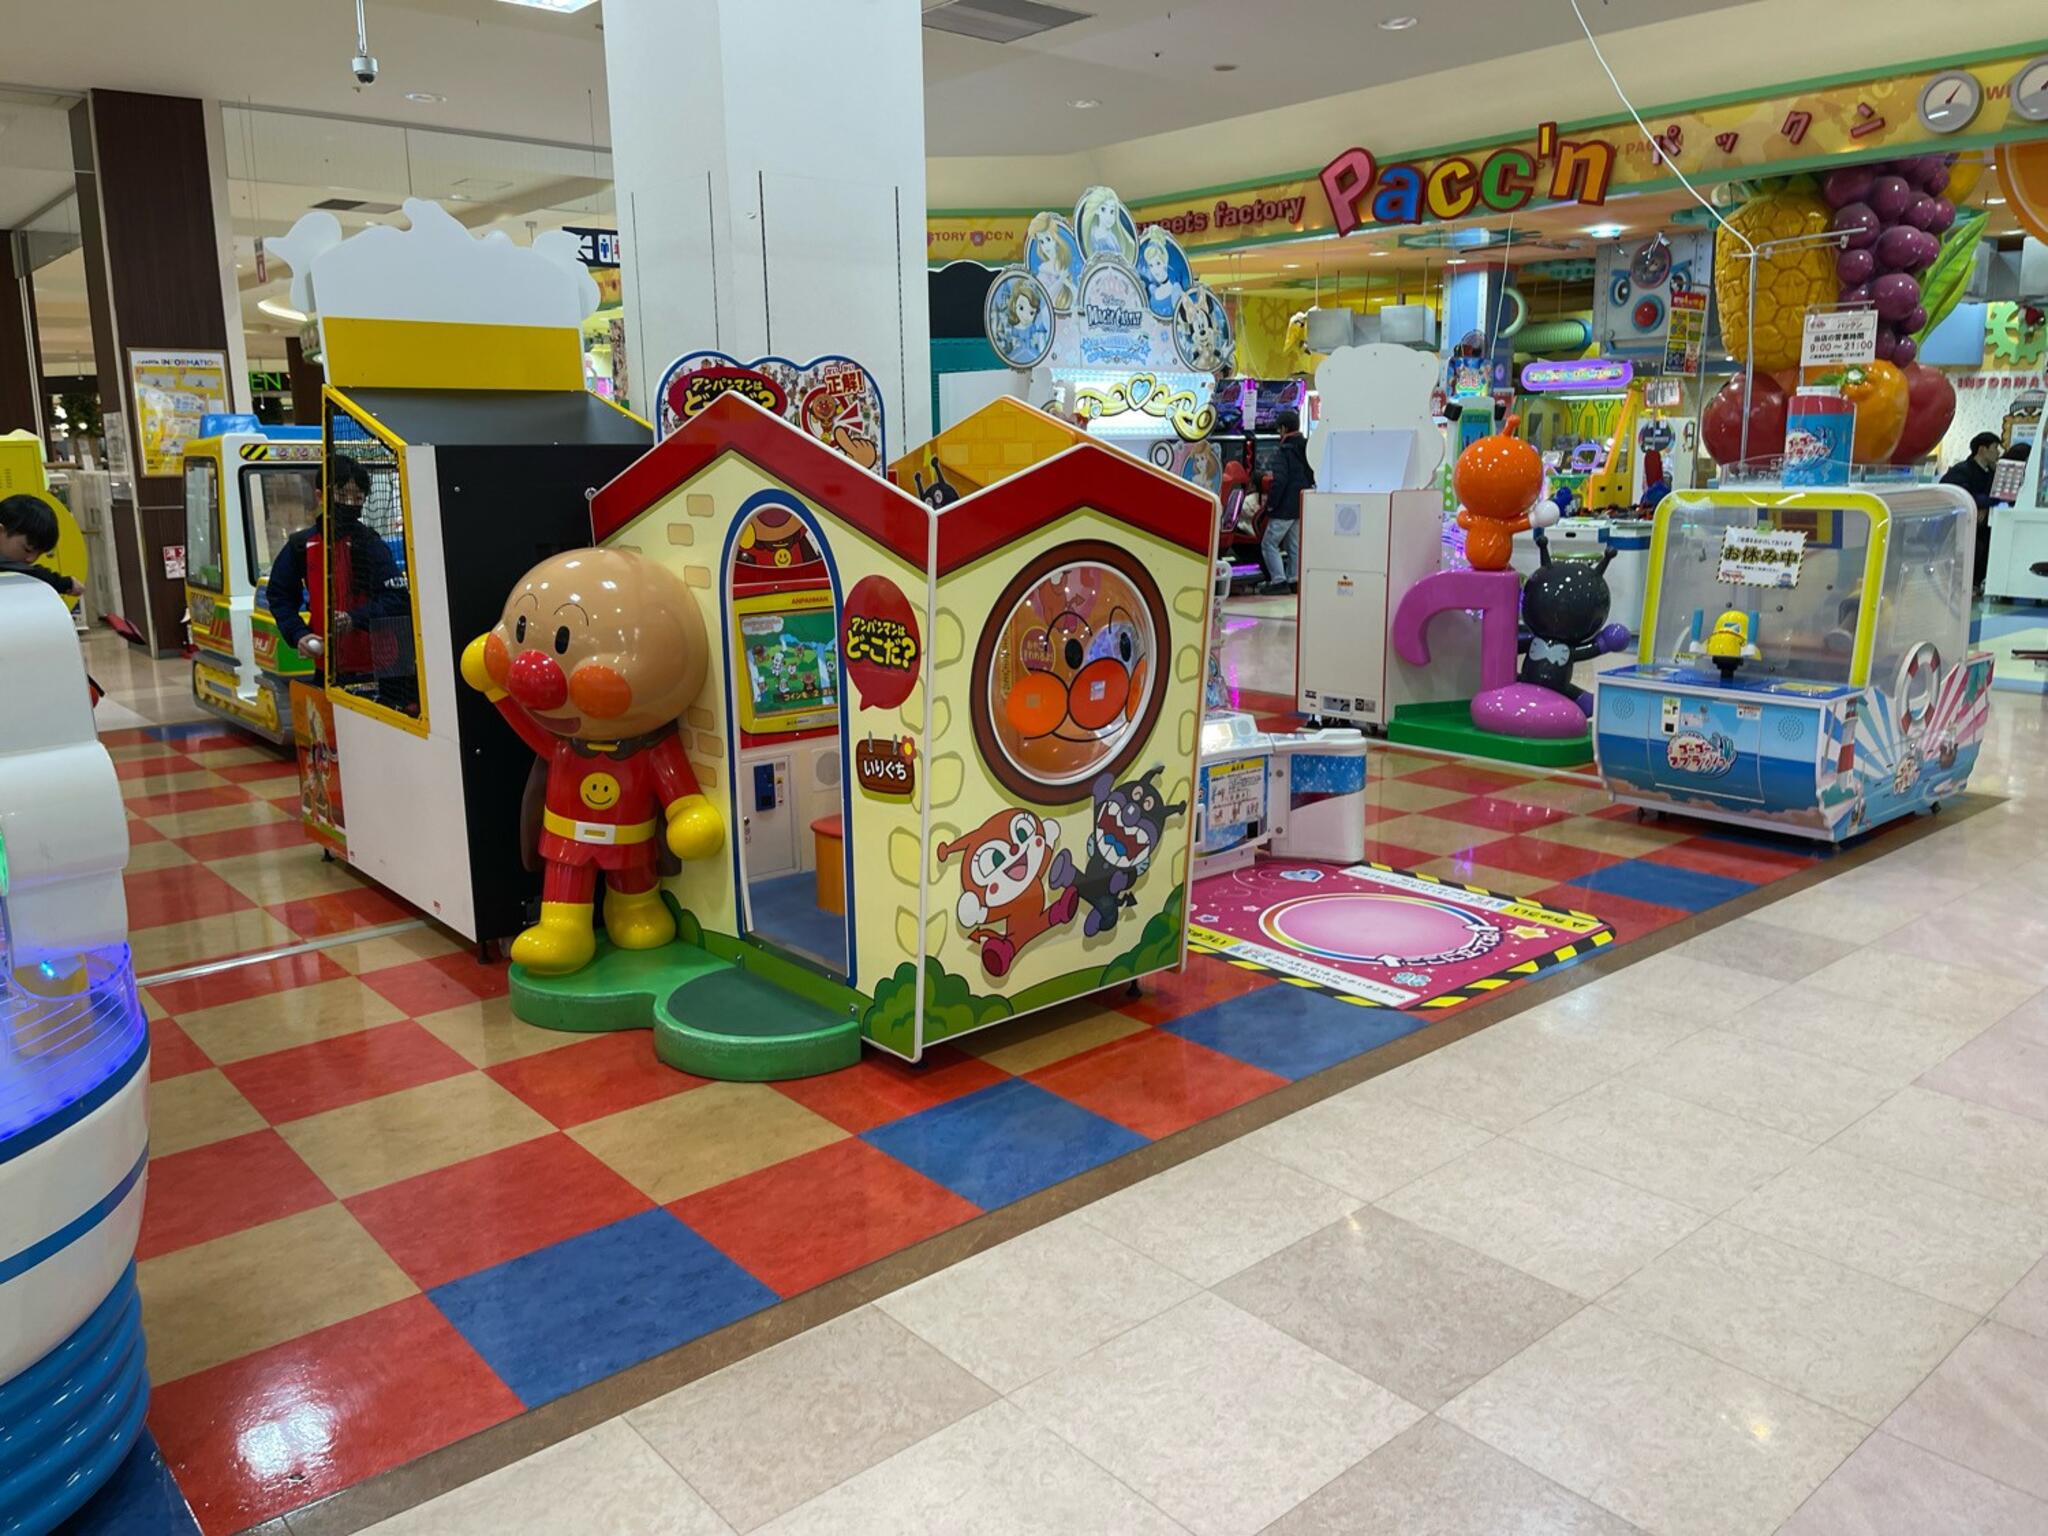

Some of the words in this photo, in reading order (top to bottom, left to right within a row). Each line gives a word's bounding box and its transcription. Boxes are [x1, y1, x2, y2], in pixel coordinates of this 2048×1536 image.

[1318, 121, 1615, 238] Pacc'n
[1214, 196, 1306, 228] factory
[161, 358, 219, 367] INORMATIO
[692, 376, 763, 391] アンパンマンは
[1723, 544, 1799, 568] お休み中
[851, 616, 906, 638] アンパンマンは
[846, 629, 917, 670] どーこだ?
[863, 759, 907, 781] いりぐち
